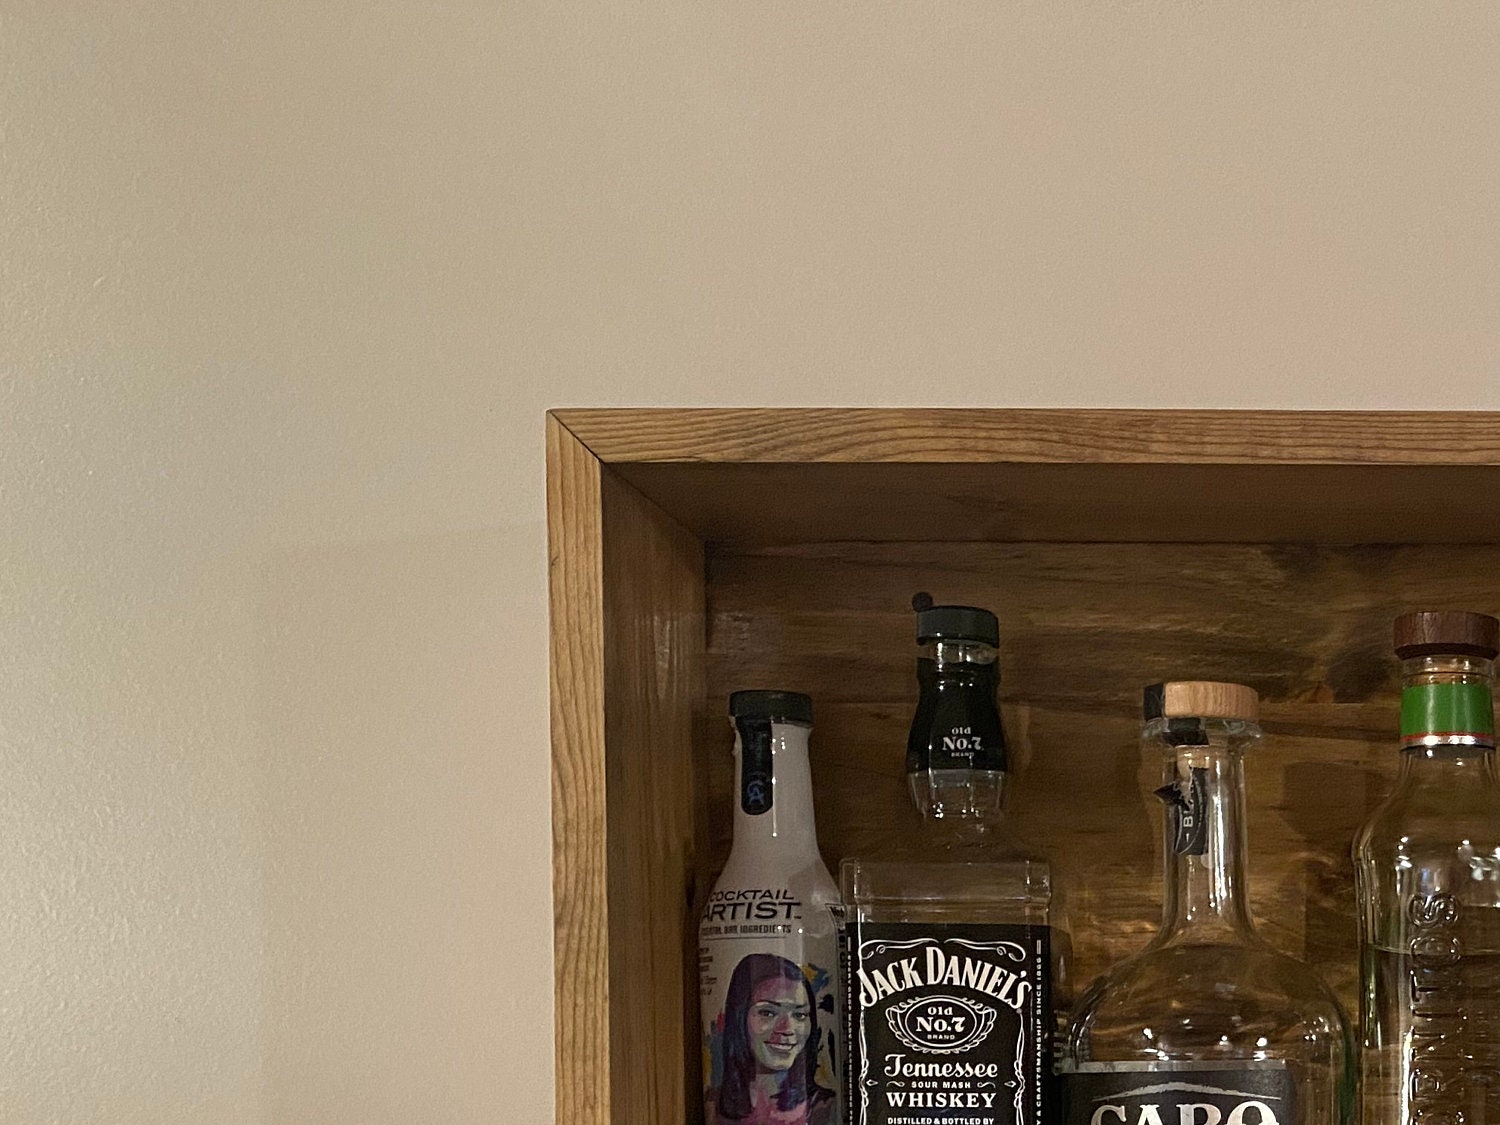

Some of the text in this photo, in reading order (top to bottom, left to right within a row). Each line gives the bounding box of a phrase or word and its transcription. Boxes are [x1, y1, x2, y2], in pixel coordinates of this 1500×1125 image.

[856, 956, 924, 1007] JACK
[926, 946, 1032, 1009] DANIEL'S
[927, 1006, 953, 1015] Old
[884, 1053, 998, 1078] Tennessee
[911, 1081, 971, 1089] SOUR MASH
[886, 1092, 997, 1108] WHISKEY
[887, 1117, 933, 1125] DISTILLED
[942, 1117, 981, 1125] BOTTLED
[983, 1117, 994, 1125] BY
